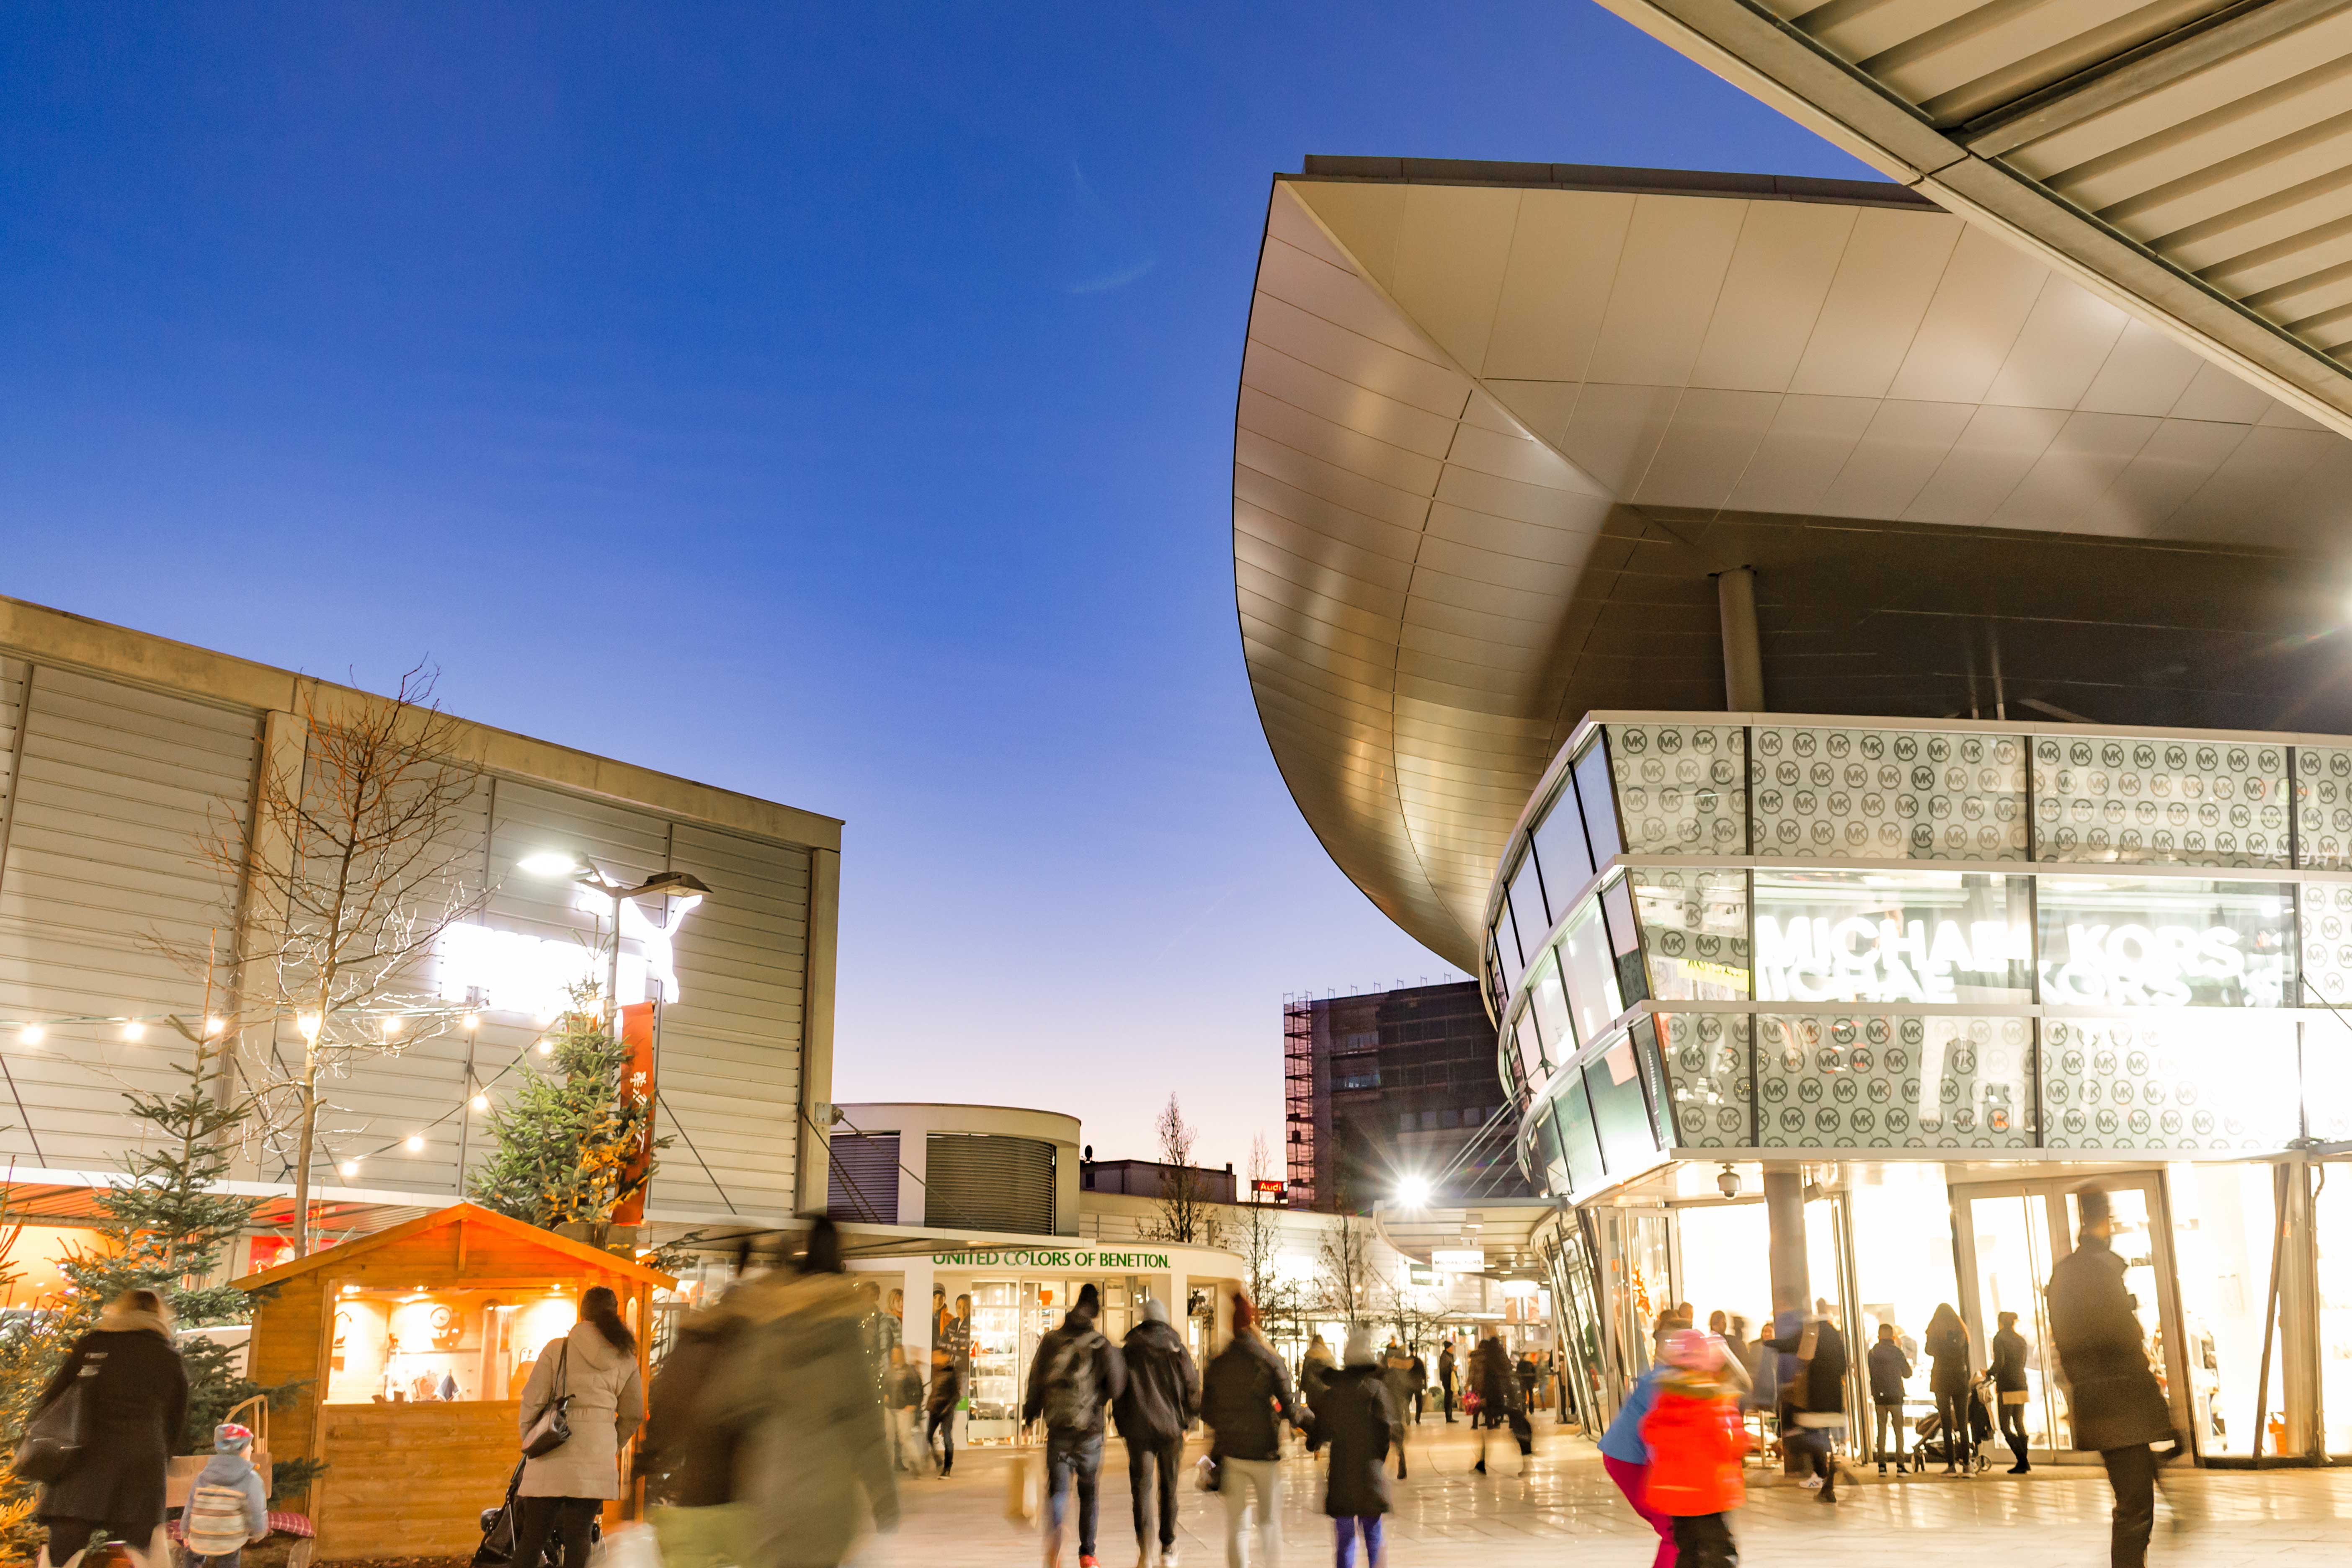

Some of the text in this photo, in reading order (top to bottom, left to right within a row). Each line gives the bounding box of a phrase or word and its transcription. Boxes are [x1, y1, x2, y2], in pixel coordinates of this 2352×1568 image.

[1755, 916, 2245, 979] MICHAE KORS
[1260, 1182, 1281, 1191] Audi
[933, 1251, 1171, 1268] UNITED COLORS OF BENETTON.
